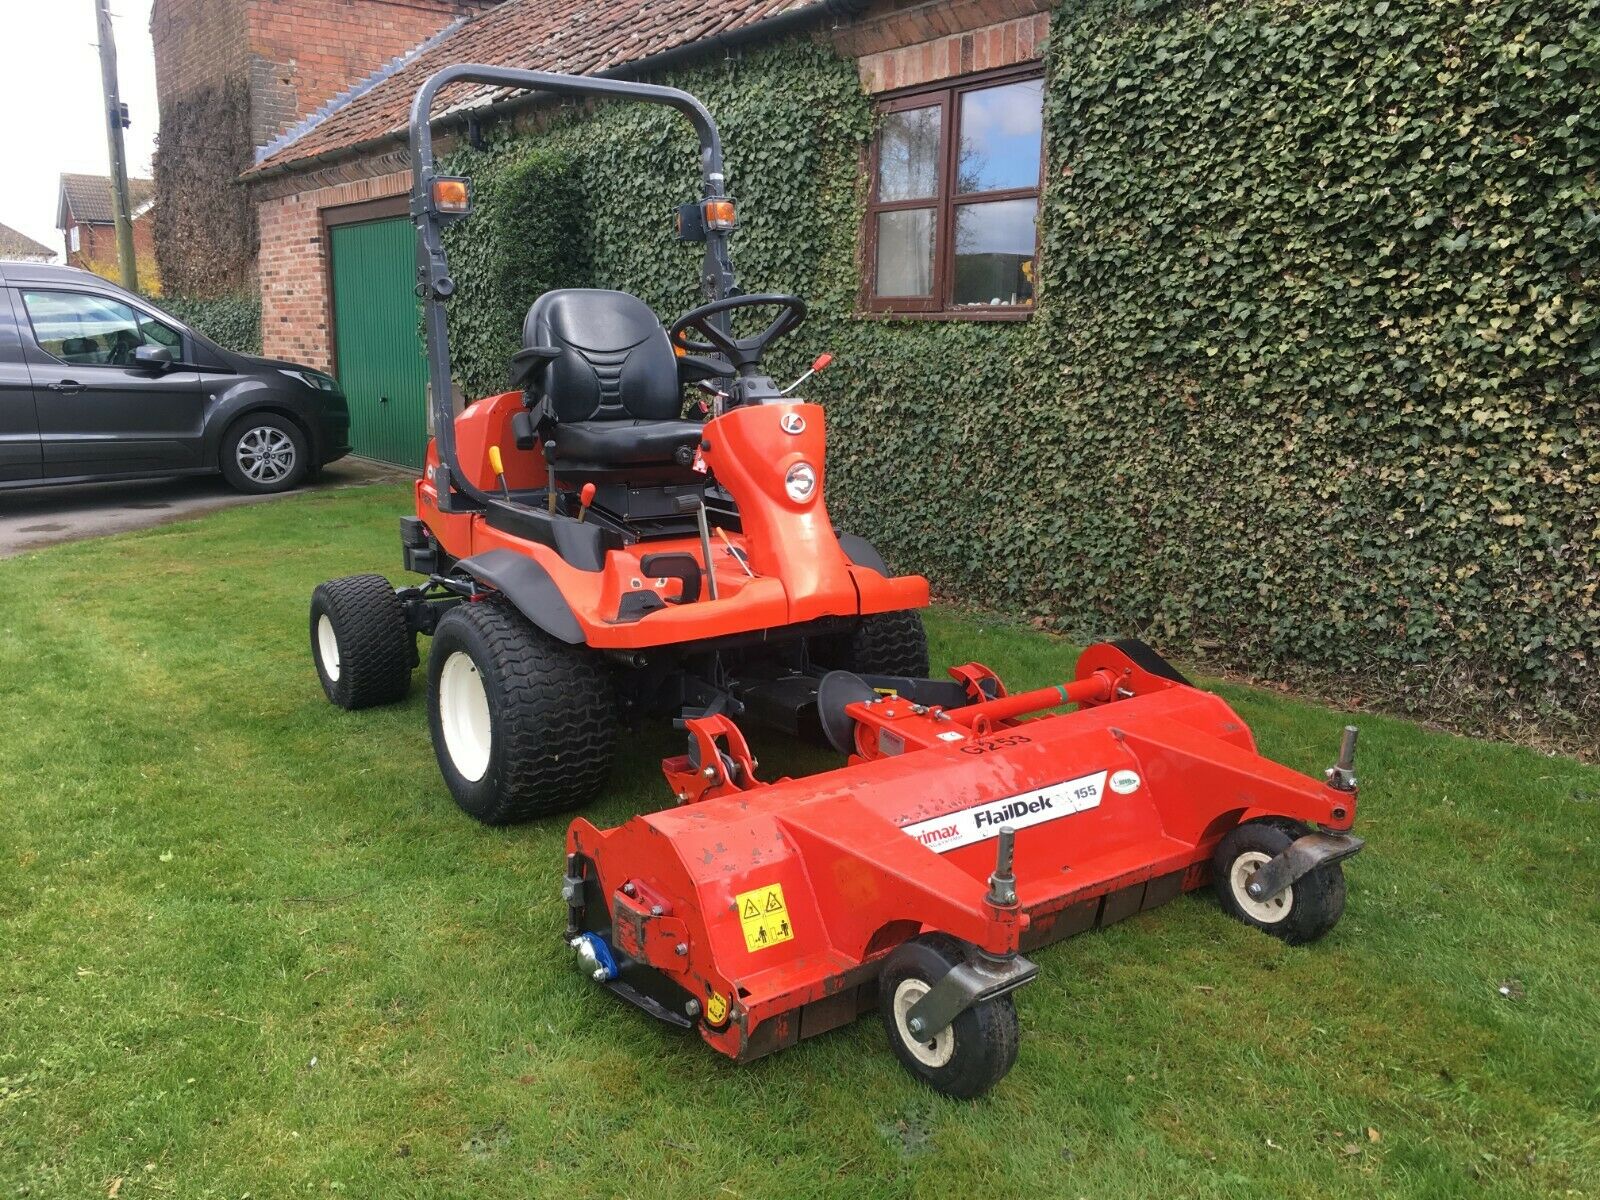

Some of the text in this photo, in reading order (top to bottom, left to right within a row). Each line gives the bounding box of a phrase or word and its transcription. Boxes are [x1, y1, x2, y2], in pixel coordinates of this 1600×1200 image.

[960, 735, 1032, 756] G253
[912, 824, 960, 844] rimax
[974, 796, 1053, 829] FlailDek
[1073, 785, 1097, 800] 155
